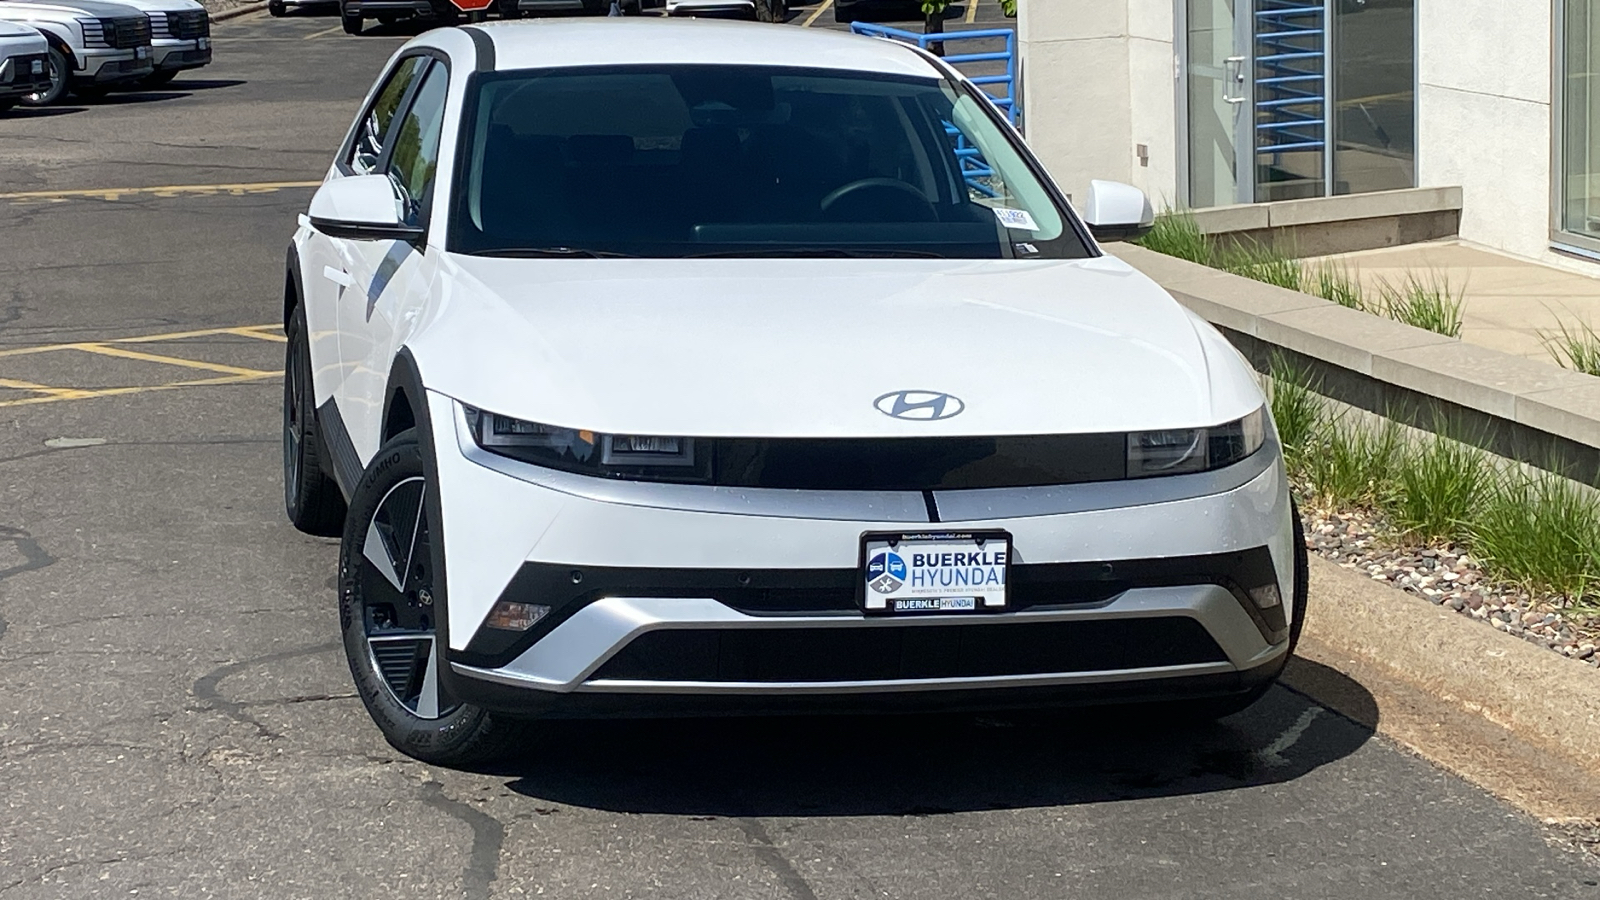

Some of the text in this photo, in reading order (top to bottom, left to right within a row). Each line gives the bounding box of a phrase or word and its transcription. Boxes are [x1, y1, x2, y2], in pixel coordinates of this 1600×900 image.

[913, 552, 1006, 567] BUERKLE
[912, 567, 1005, 587] HYUNDAI
[896, 598, 973, 609] BUERKLE HYUNDAI
